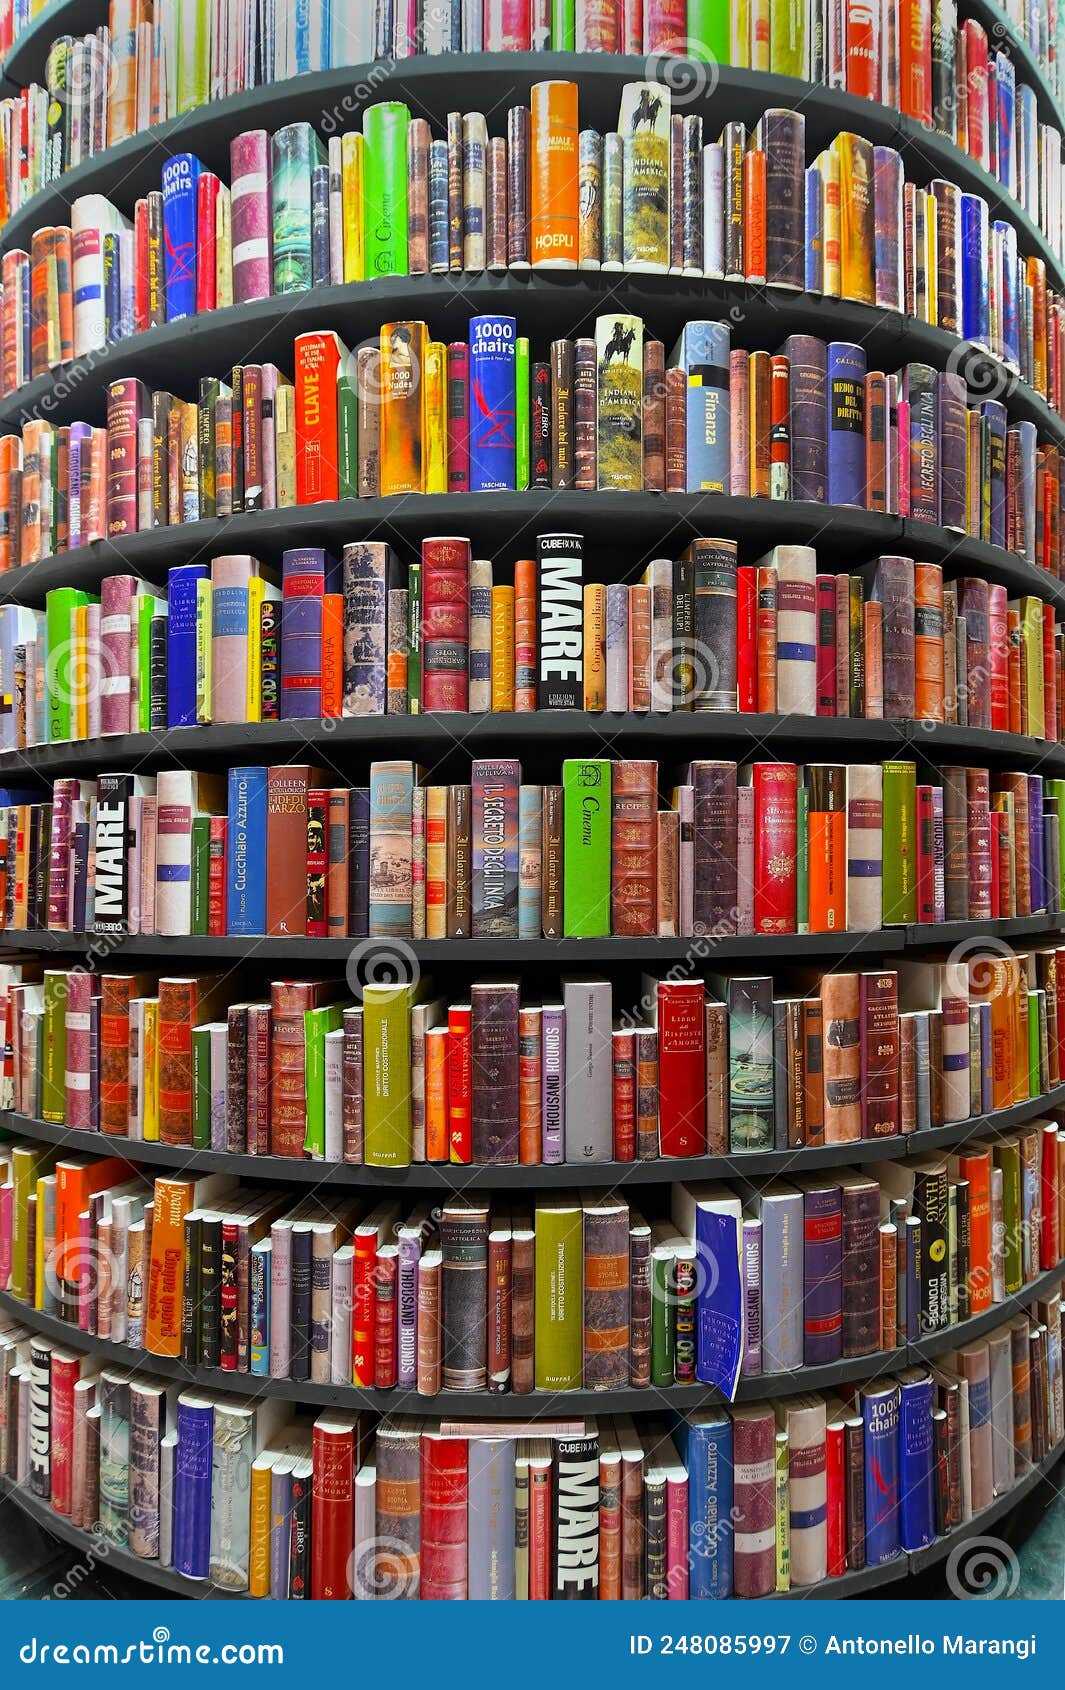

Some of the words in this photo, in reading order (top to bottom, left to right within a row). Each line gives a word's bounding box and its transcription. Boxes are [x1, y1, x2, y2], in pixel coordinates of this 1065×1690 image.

[163, 160, 189, 183] 1000
[376, 193, 392, 242] Cinema
[535, 234, 574, 249] HOEPLI
[475, 323, 512, 339] 1000
[472, 338, 515, 355] chairs
[391, 371, 410, 380] 1000
[833, 382, 854, 393] MEDIO
[304, 373, 320, 426] CLAVE
[557, 387, 568, 400] Il
[604, 389, 636, 397] INDIANI
[844, 396, 858, 407] DEL
[921, 391, 934, 416] INCA
[541, 406, 549, 438] LIBRO
[558, 401, 568, 430] colore
[705, 391, 719, 445] Finanza
[837, 407, 862, 421] DIRITTO
[559, 431, 568, 449] del
[921, 418, 934, 448] DEGLI
[71, 447, 81, 496] THOUSAND
[154, 450, 163, 473] colore
[558, 450, 568, 469] male
[921, 448, 935, 490] SEGRETO
[154, 488, 163, 510] male
[921, 490, 934, 503] IL
[70, 498, 80, 536] HOUNDS
[541, 540, 582, 550] CUBEBOOK
[541, 557, 582, 681] MARE
[592, 588, 601, 630] italiana
[427, 657, 466, 665] GARDENING
[495, 602, 504, 698] ANDALUSIA
[269, 780, 306, 788] COLLEEN
[484, 783, 504, 795] IL
[238, 781, 248, 829] Azzurro
[268, 803, 306, 813] MARZO
[484, 796, 505, 845] SEGRETO
[582, 796, 600, 847] Cinema
[457, 835, 468, 848] Il
[549, 835, 560, 848] Il
[934, 817, 944, 868] THOUSAND
[95, 802, 124, 915] MARE
[235, 831, 247, 890] Cucchiaio
[457, 849, 468, 880] colore
[484, 848, 505, 879] DEGLI
[549, 849, 560, 882] colore
[457, 880, 468, 896] del
[484, 880, 504, 911] INCA
[549, 882, 560, 896] del
[934, 868, 944, 909] HOUNDS
[456, 897, 467, 918] male
[549, 897, 560, 918] male
[671, 1015, 696, 1023] LIBRO
[546, 1027, 560, 1073] HOUNDS
[793, 1049, 803, 1060] Il
[794, 1061, 803, 1089] colore
[547, 1075, 560, 1132] THOUSAND
[794, 1089, 803, 1105] del
[795, 1106, 803, 1128] male
[547, 1134, 560, 1142] A
[155, 1185, 167, 1223] Harris
[168, 1186, 186, 1227] Joanne
[926, 1181, 939, 1224] HAIG
[938, 1172, 948, 1225] BRIAN
[747, 1243, 760, 1287] HOUNDS
[401, 1268, 414, 1326] THOUSAND
[929, 1278, 939, 1326] D'ONORE
[940, 1272, 948, 1326] MISSIONE
[748, 1287, 760, 1345] THOUSAND
[401, 1328, 415, 1374] HOUNDS
[871, 1397, 899, 1418] 1000
[869, 1414, 899, 1433] chairs
[559, 1441, 599, 1453] CUBEBOOK
[705, 1441, 718, 1491] Azzurro
[255, 1484, 266, 1582] ANDALUSIA
[296, 1521, 305, 1553] LIBRO
[558, 1459, 599, 1591] MARE
[705, 1495, 718, 1558] Cucchiaio
